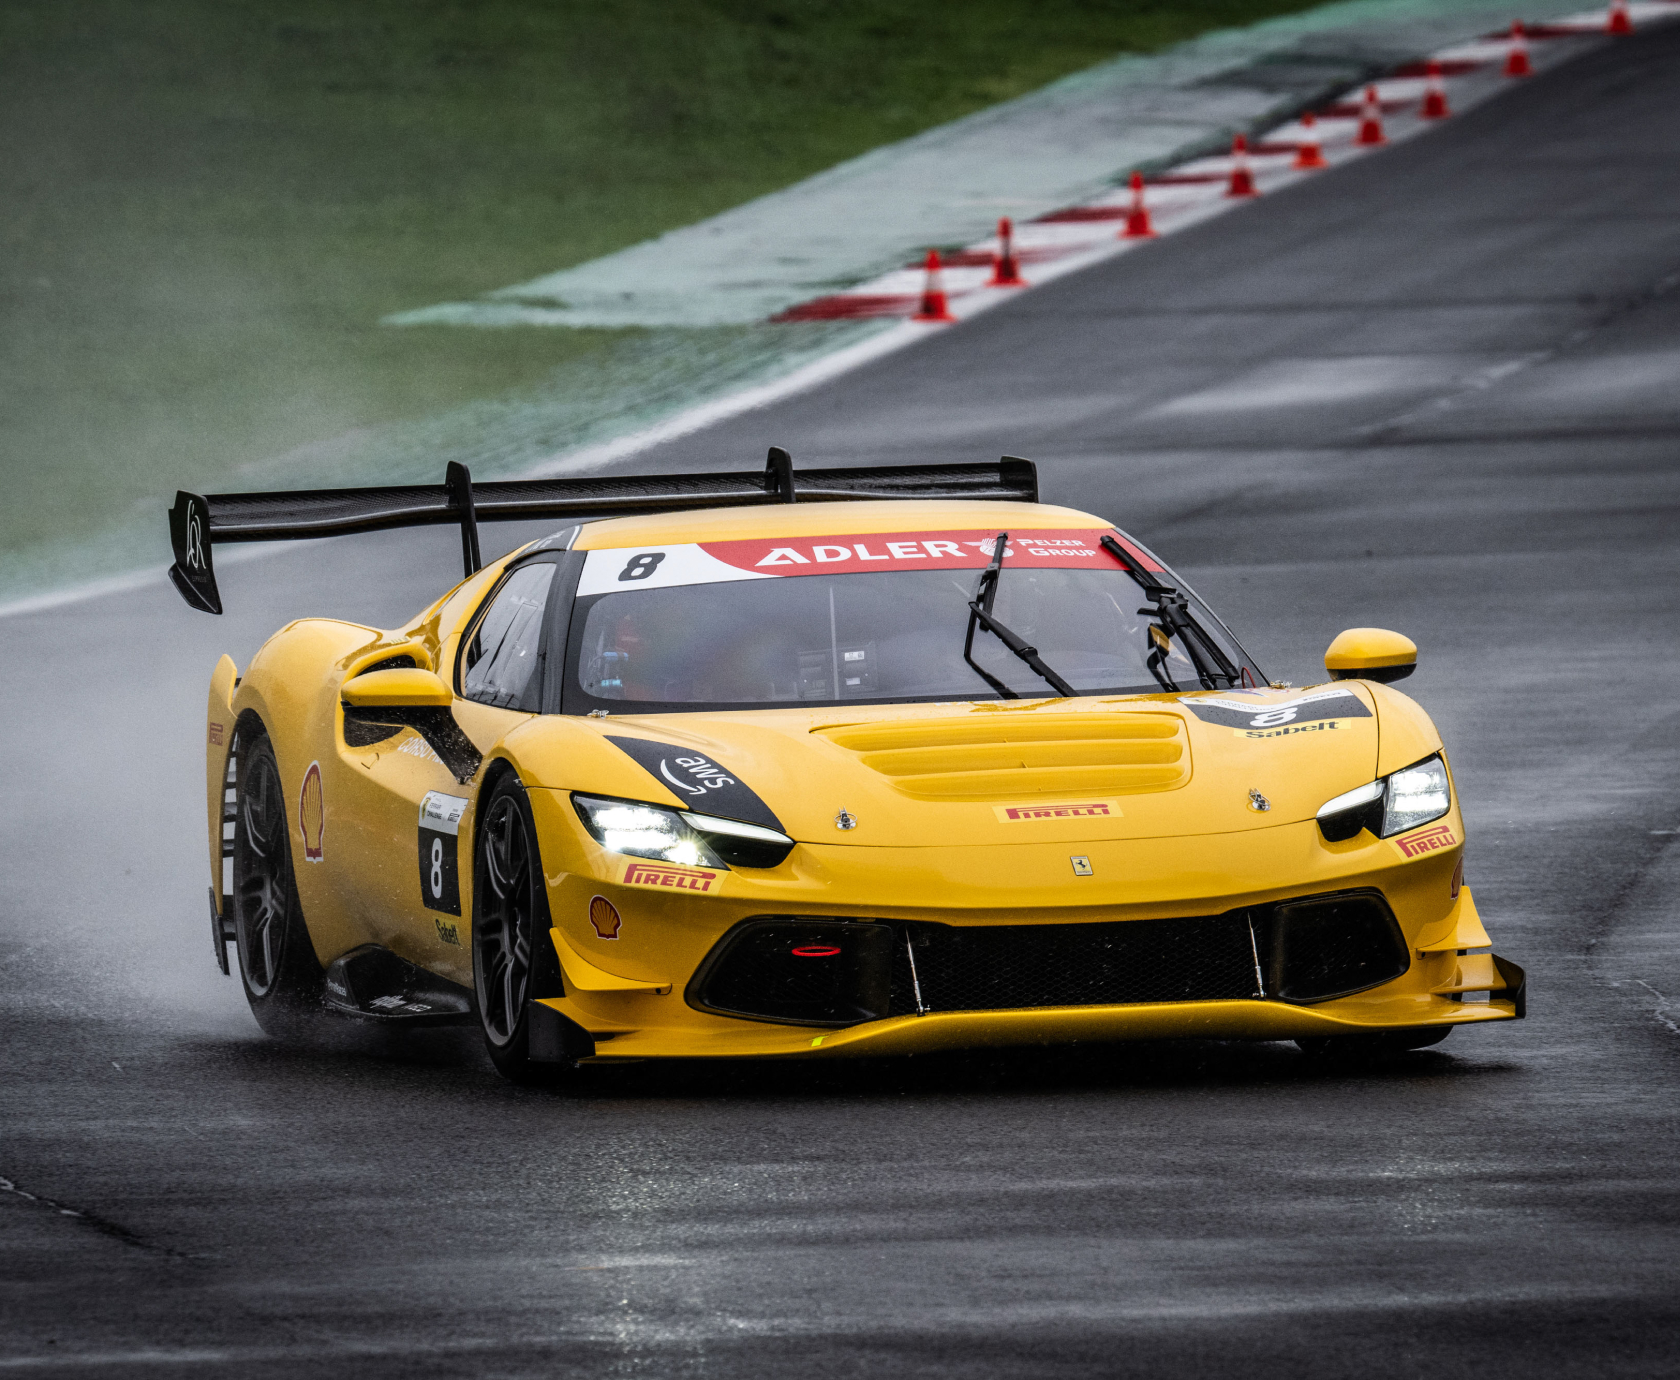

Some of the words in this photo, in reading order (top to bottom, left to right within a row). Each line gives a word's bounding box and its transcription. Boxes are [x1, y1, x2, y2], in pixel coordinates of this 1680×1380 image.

[754, 539, 968, 567] ADLER
[1016, 538, 1086, 547] PELZER
[1028, 547, 1097, 557] GROUP
[617, 552, 666, 582] 8
[1245, 721, 1340, 739] Sabelt
[1249, 707, 1298, 727] 8
[674, 756, 735, 789] aws
[1005, 803, 1111, 820] PIRELLI
[1394, 825, 1457, 858] PIRELLI
[430, 837, 443, 899] 8
[623, 863, 717, 892] PIRELLI
